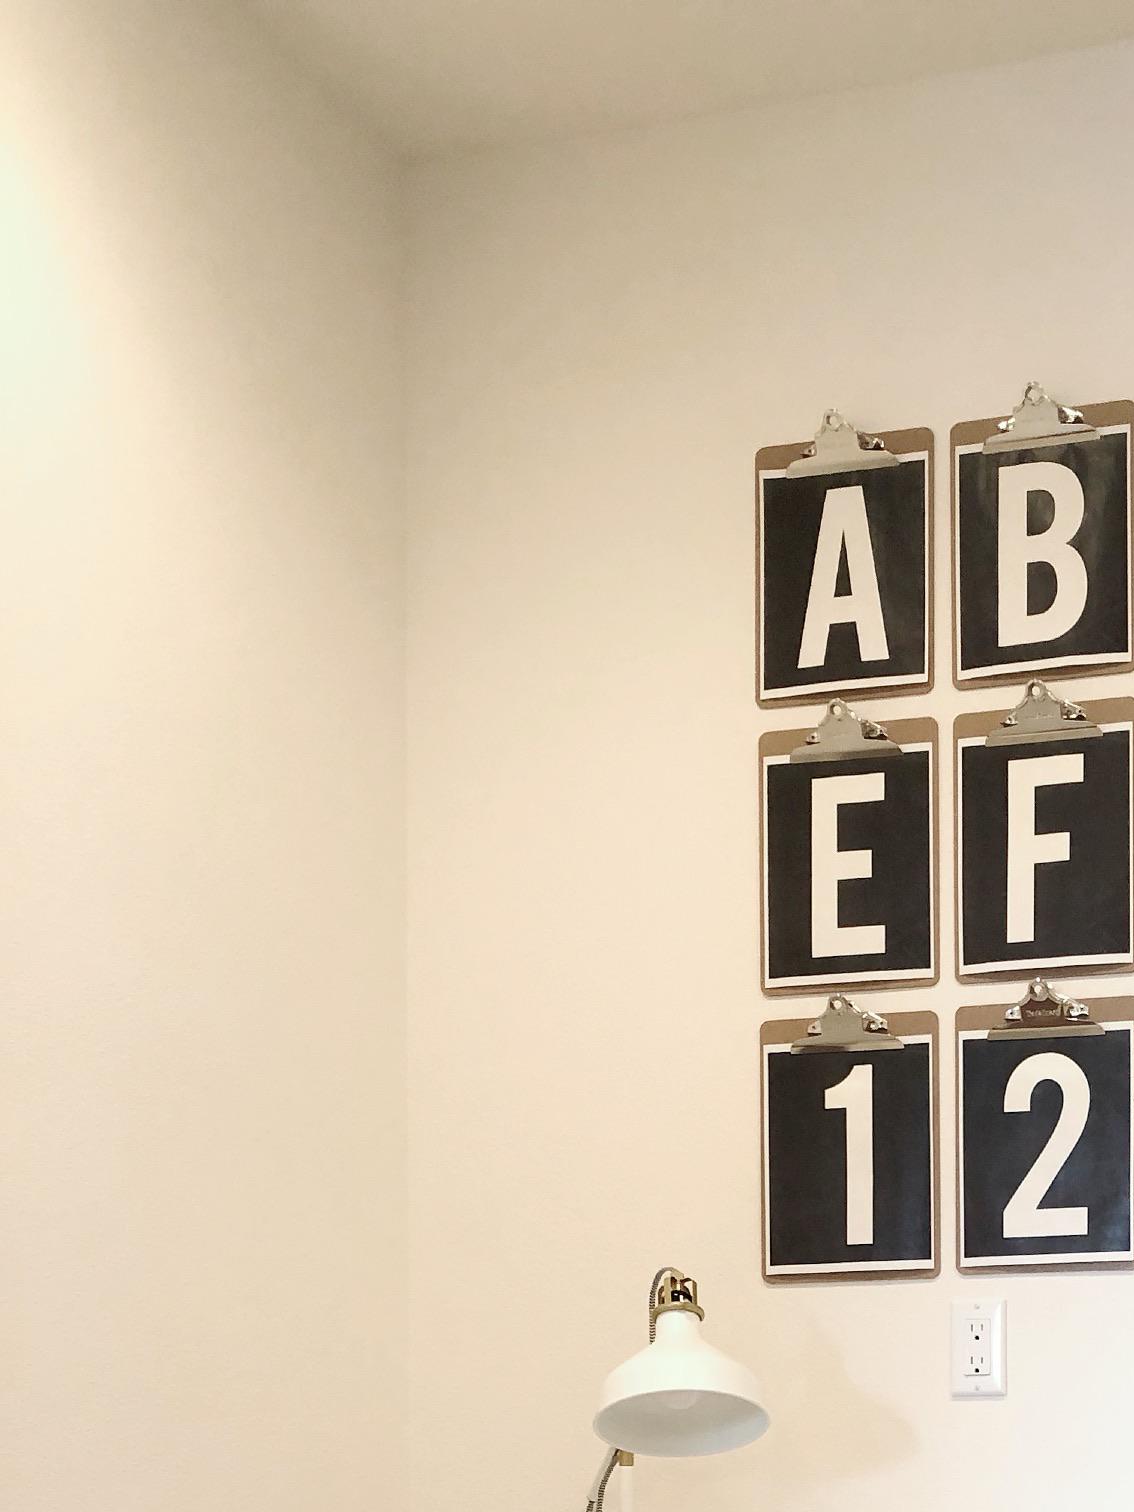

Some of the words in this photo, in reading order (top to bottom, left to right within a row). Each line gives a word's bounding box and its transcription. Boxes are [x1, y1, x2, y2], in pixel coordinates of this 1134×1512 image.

[798, 486, 889, 668] A
[998, 462, 1087, 647] B
[812, 773, 885, 958] E
[1007, 754, 1084, 943] F
[825, 1064, 873, 1245] 1
[1003, 1053, 1090, 1238] 2
